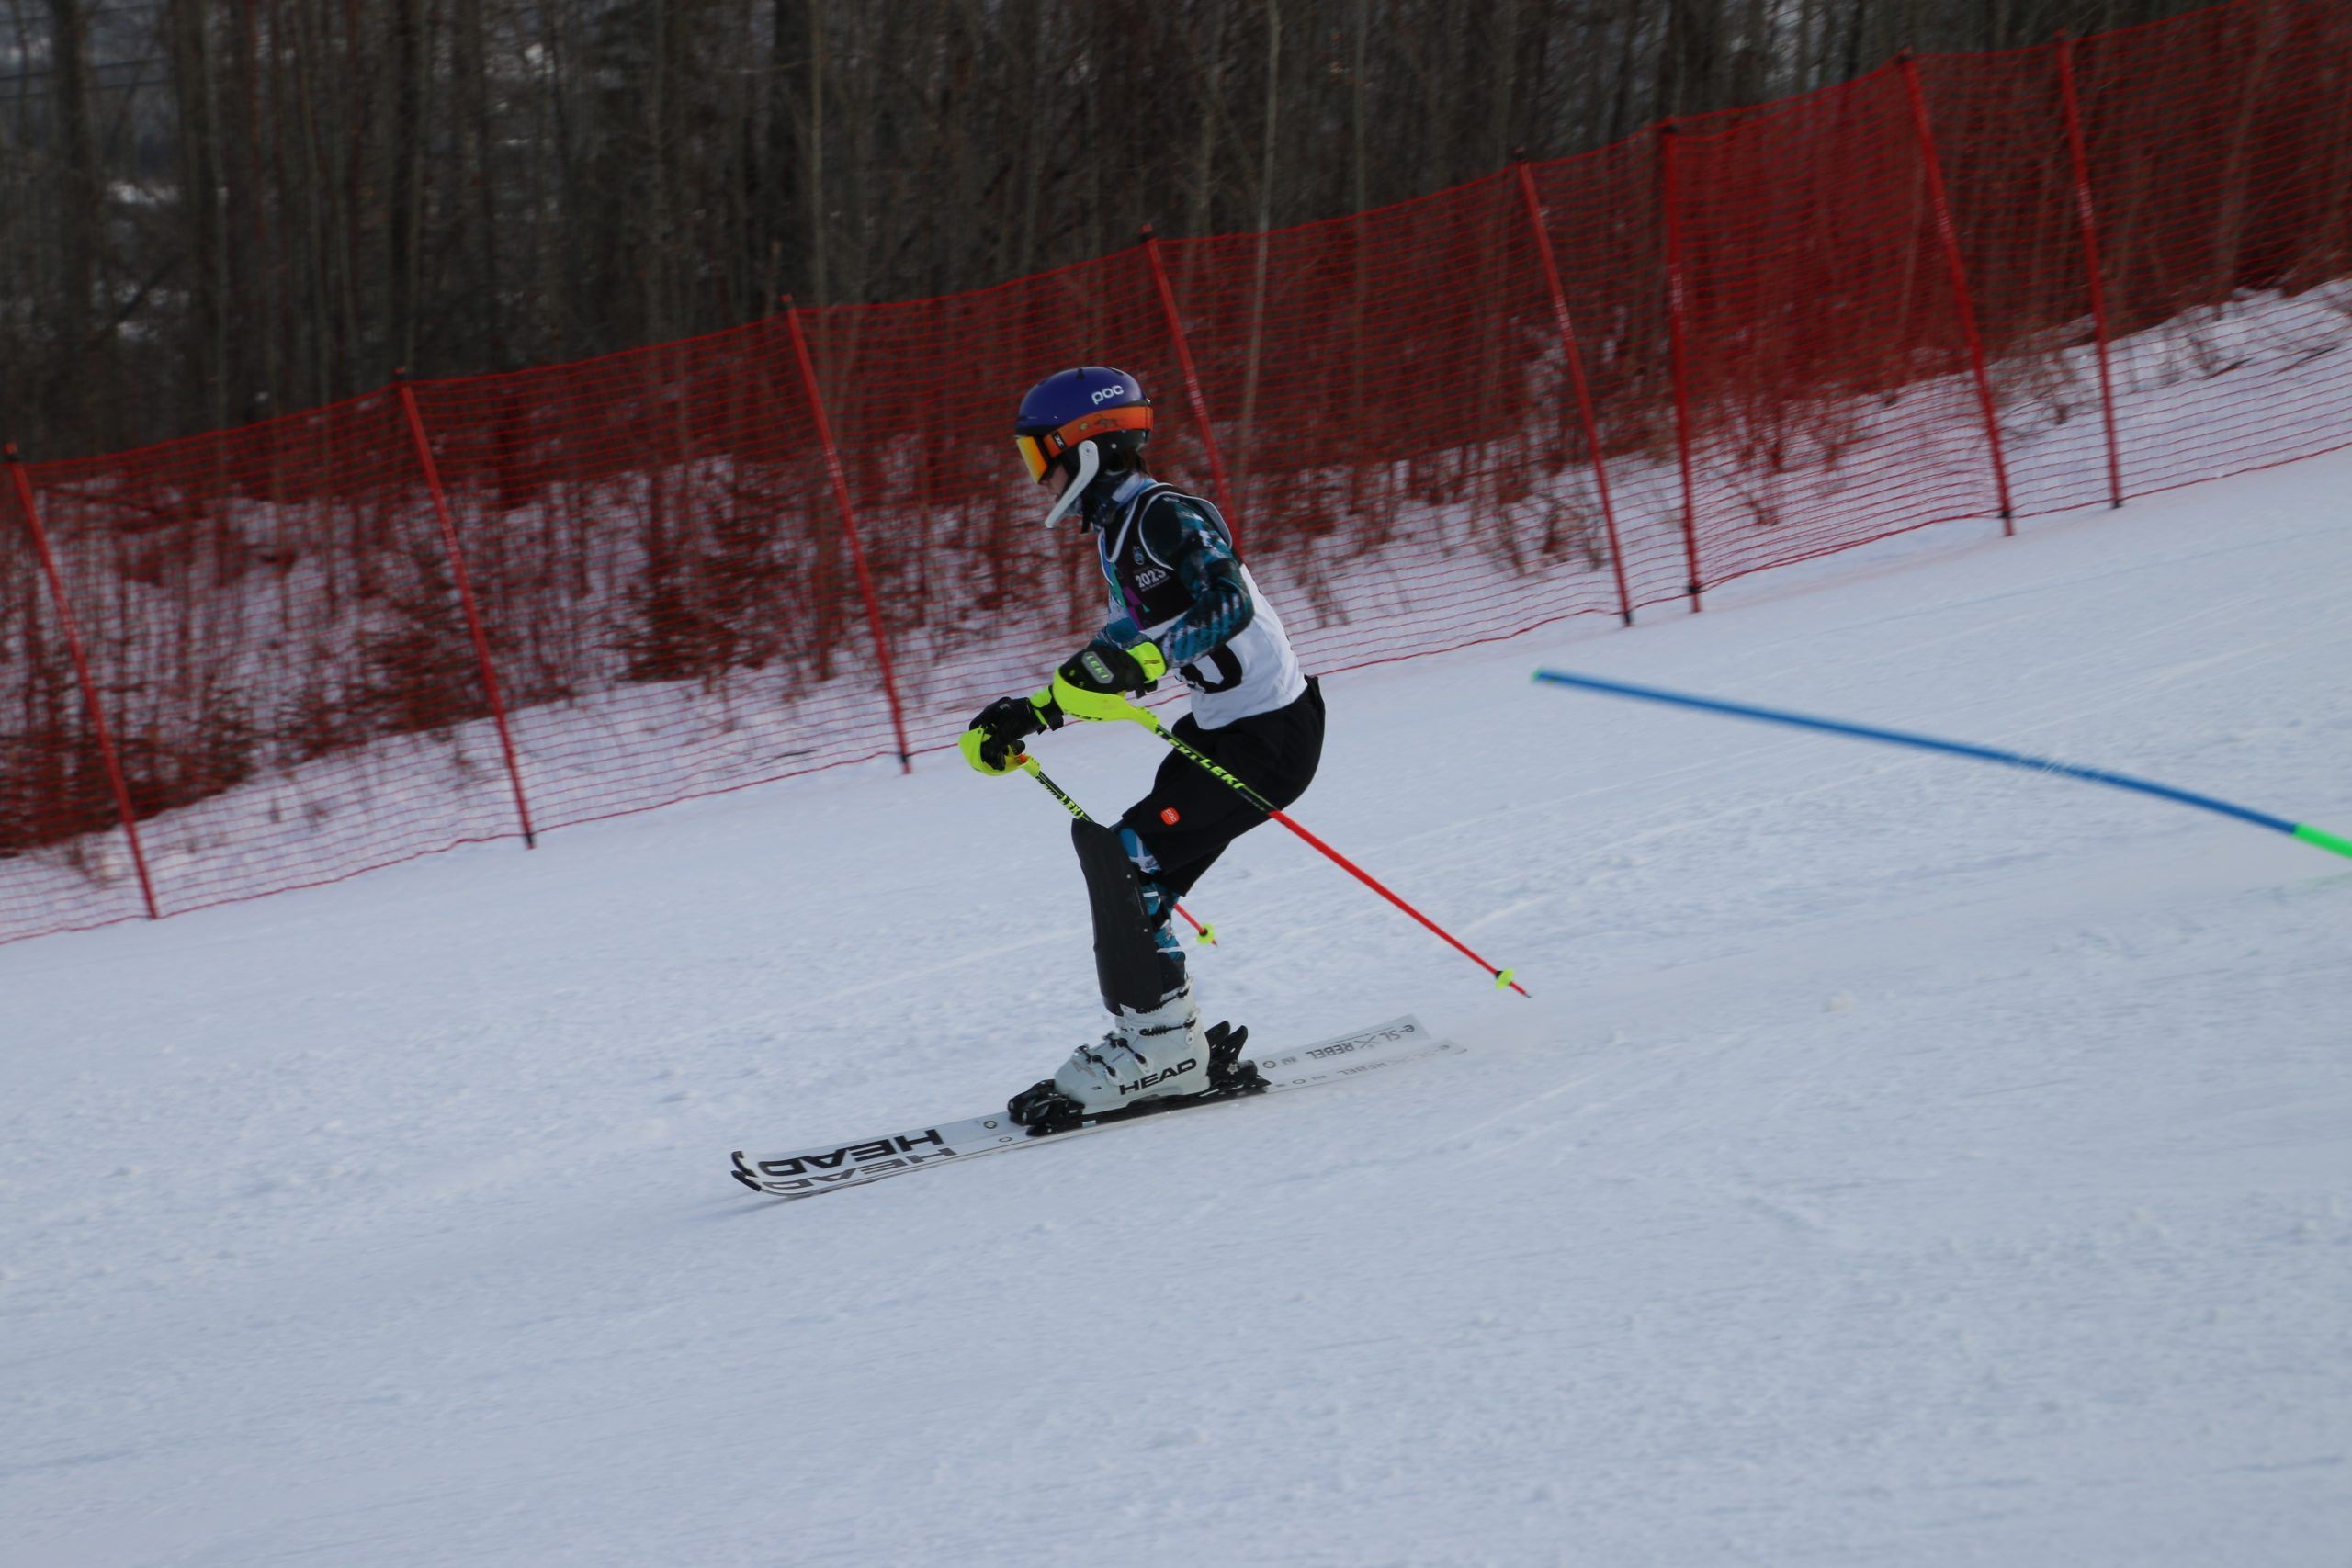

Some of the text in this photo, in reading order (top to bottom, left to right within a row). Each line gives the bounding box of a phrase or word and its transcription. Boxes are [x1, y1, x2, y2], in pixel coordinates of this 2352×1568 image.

[1091, 385, 1124, 405] poc
[1135, 569, 1166, 588] 2023
[1086, 656, 1109, 679] LEKI
[1200, 758, 1245, 789] LEKI
[1306, 1042, 1355, 1060] REBEL
[1119, 1058, 1197, 1095] HEAD
[758, 1129, 944, 1177] HEAD
[762, 1147, 957, 1190] HEAD
